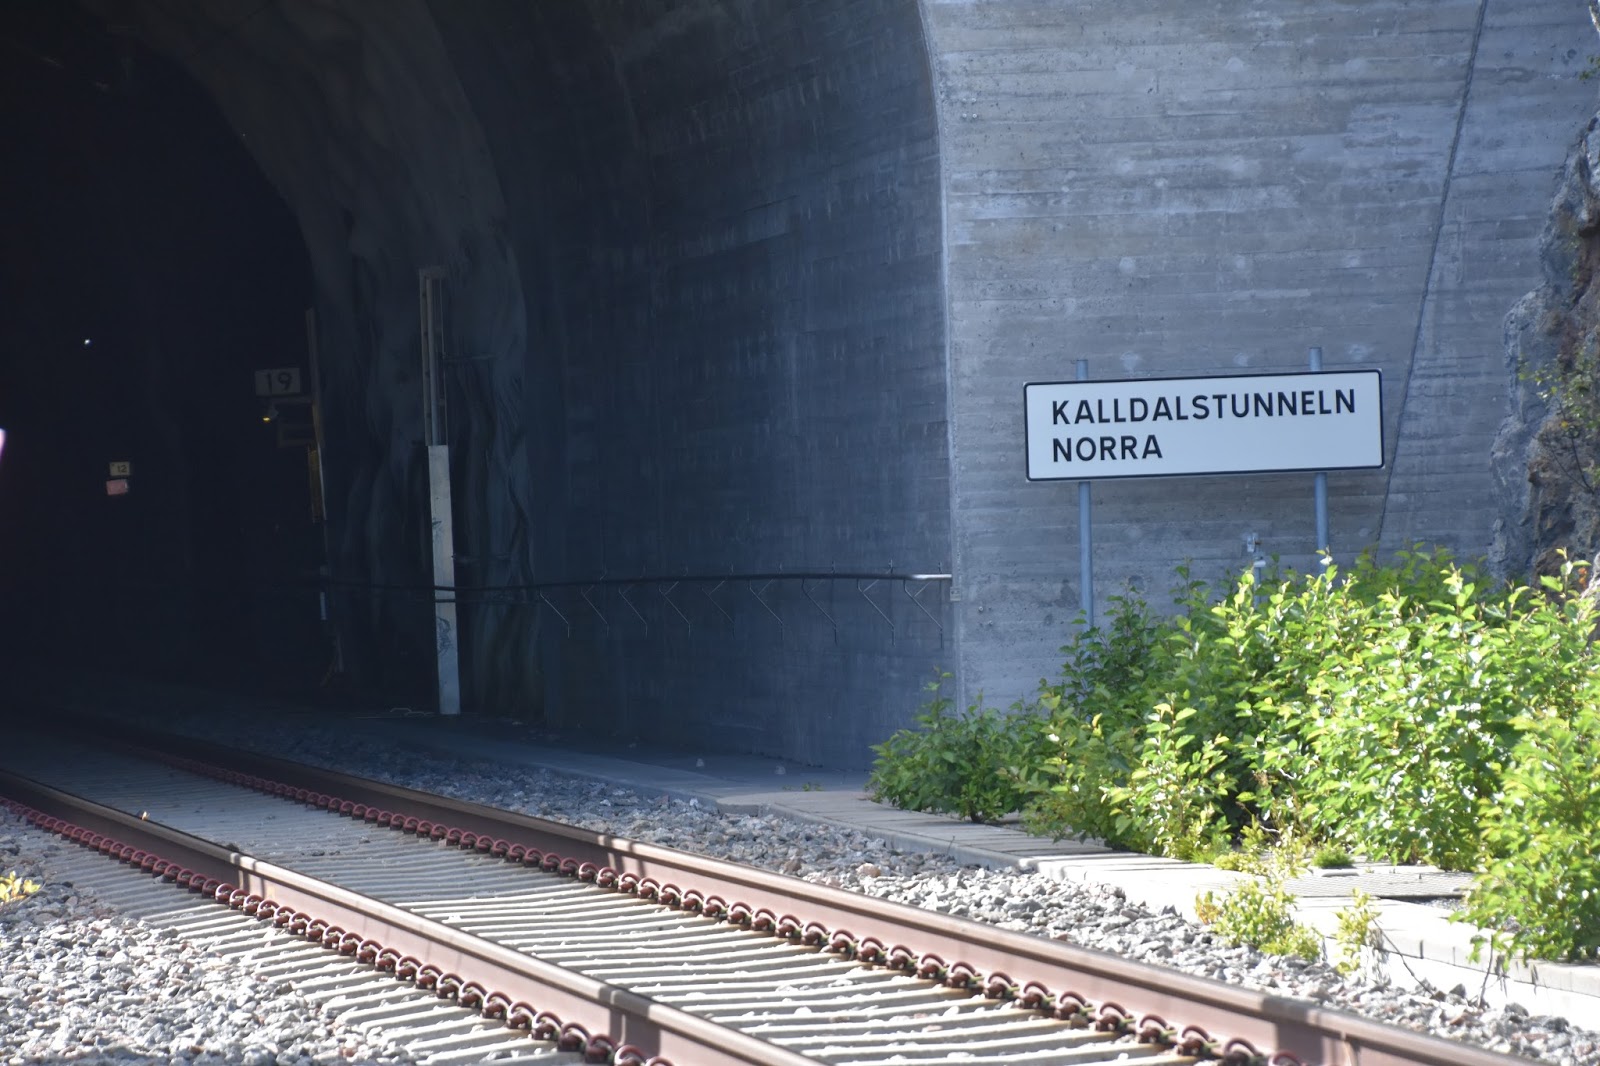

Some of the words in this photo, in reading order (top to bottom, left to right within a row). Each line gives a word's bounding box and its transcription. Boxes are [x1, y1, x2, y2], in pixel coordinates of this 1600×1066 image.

[266, 371, 293, 392] 19
[1052, 388, 1356, 425] KALLDALSTUNNELN
[1052, 434, 1163, 462] NORRA
[117, 464, 127, 473] 12
